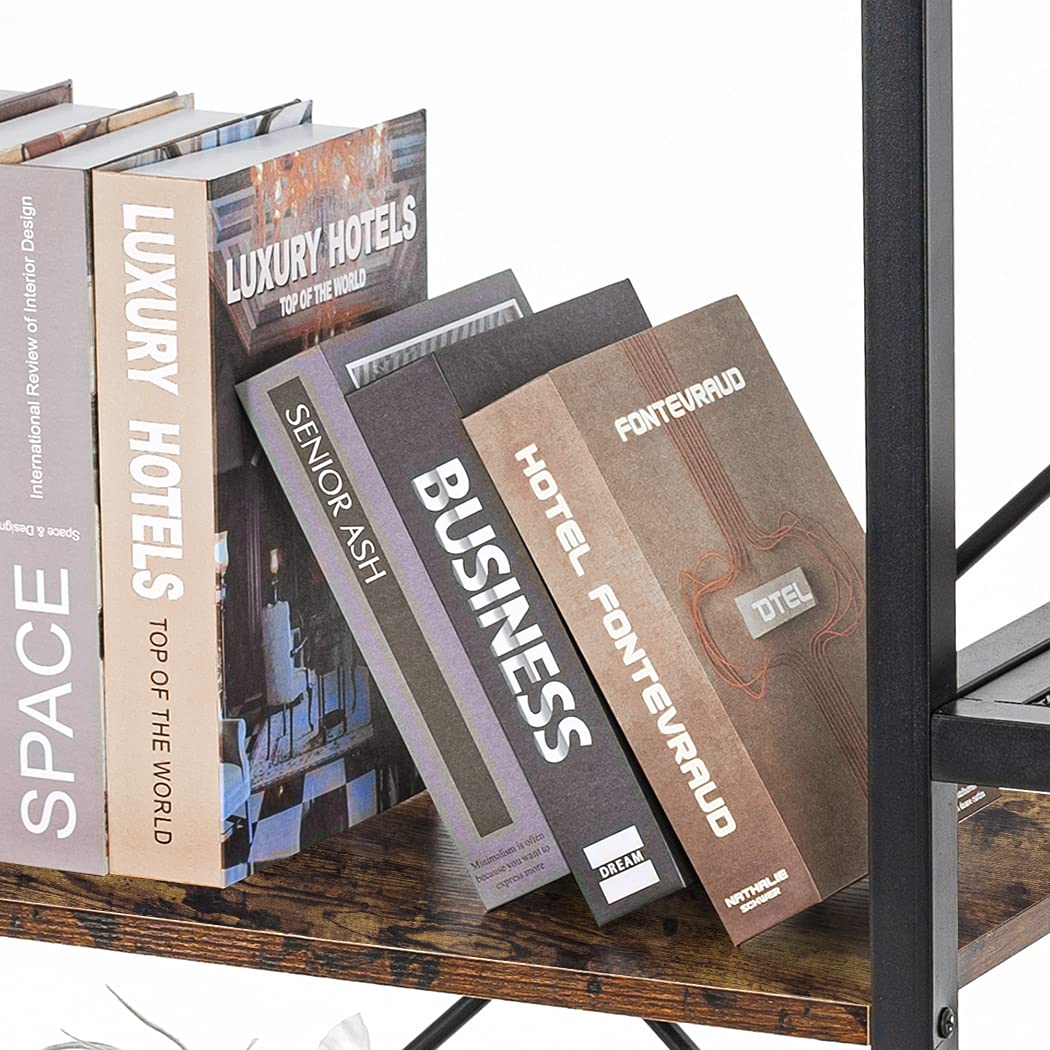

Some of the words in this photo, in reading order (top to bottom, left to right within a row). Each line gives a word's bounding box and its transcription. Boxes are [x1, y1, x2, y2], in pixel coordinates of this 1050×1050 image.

[20, 196, 36, 252] Design
[226, 227, 322, 305] LUXURY
[328, 194, 418, 268] HOTELS
[22, 256, 37, 312] Interior
[122, 203, 180, 397] LUXURY
[279, 293, 299, 317] TOP
[299, 286, 315, 309] OF
[314, 279, 334, 305] THE
[333, 267, 367, 298] WORLD
[23, 316, 38, 333] of
[25, 336, 40, 396] Review
[614, 366, 747, 443] FONTEVRAUD
[26, 401, 44, 499] International
[127, 419, 185, 602] HOTELS
[285, 402, 353, 519] SENIOR
[339, 523, 388, 586] ASH
[0, 519, 34, 536] Design
[48, 525, 81, 541] Space
[411, 456, 593, 764] BUSINESS
[148, 617, 169, 664] TOP
[514, 443, 592, 578] HOTEL
[587, 584, 738, 839] FONTEVRAUD
[13, 563, 77, 840] SPACE
[149, 671, 171, 702] OF
[150, 708, 171, 754] THE
[152, 760, 173, 846] WORLD
[470, 845, 517, 869] Minimalism
[598, 849, 645, 879] DREAM
